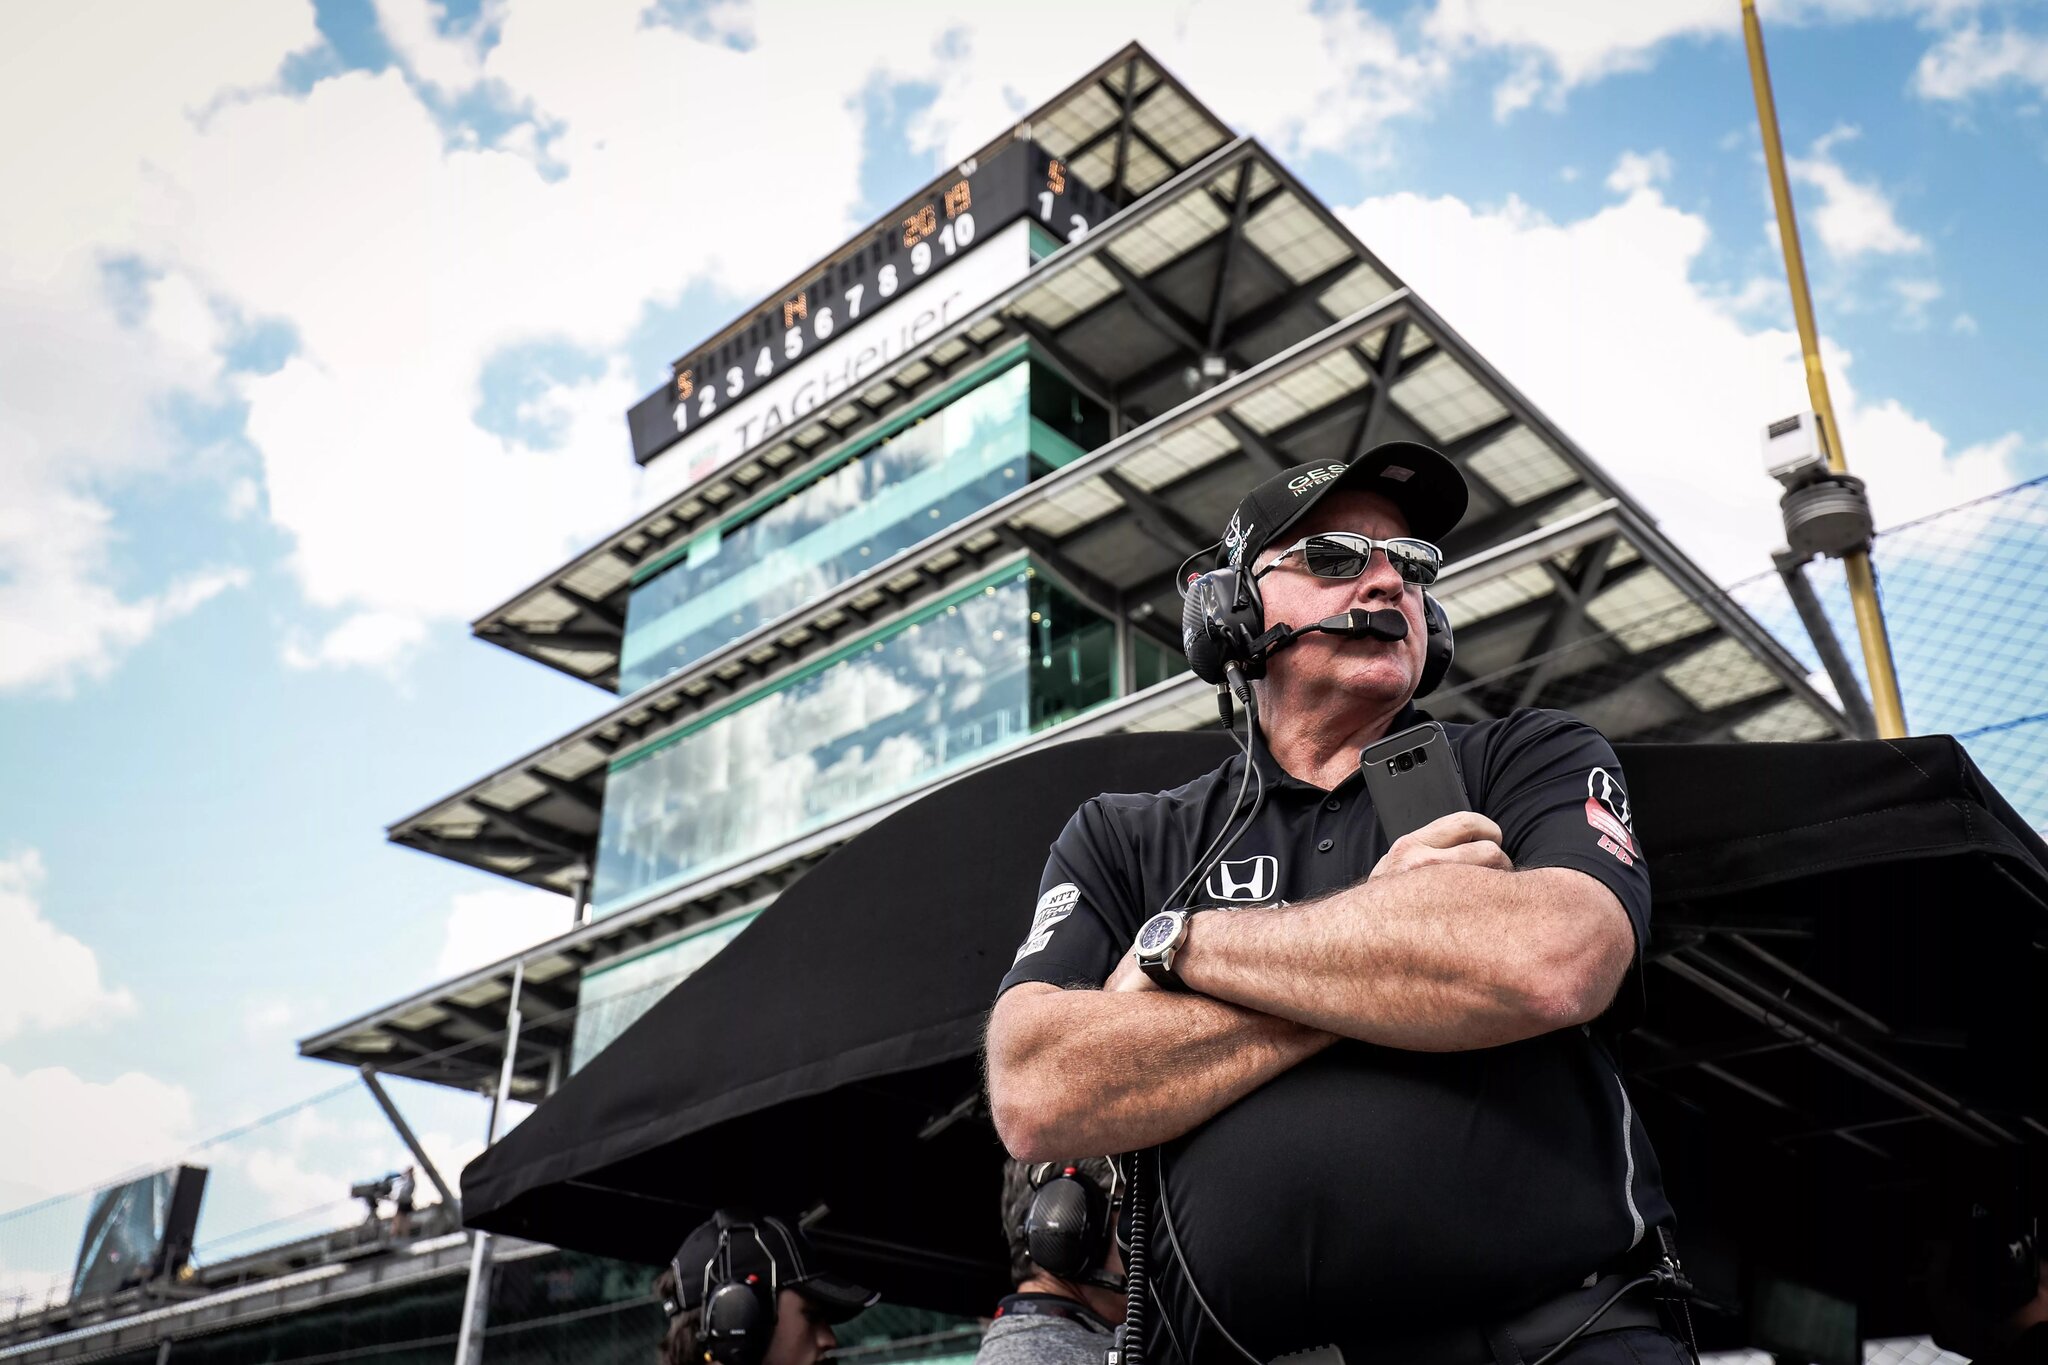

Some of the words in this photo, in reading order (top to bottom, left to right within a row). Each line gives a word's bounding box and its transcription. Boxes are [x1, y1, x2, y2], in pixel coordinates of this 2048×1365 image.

[1038, 191, 1054, 221] 1
[1067, 214, 1089, 244] 2
[673, 402, 688, 432] 1
[698, 384, 717, 418] 2
[726, 366, 745, 398] 3
[754, 346, 774, 377] 4
[784, 326, 804, 360] 5
[814, 307, 834, 340] 6
[845, 284, 865, 319] 7
[877, 264, 899, 297] 8
[910, 241, 932, 275] 9
[938, 213, 975, 256] 10
[1288, 464, 1350, 490] GES
[1049, 890, 1076, 905] NTT
